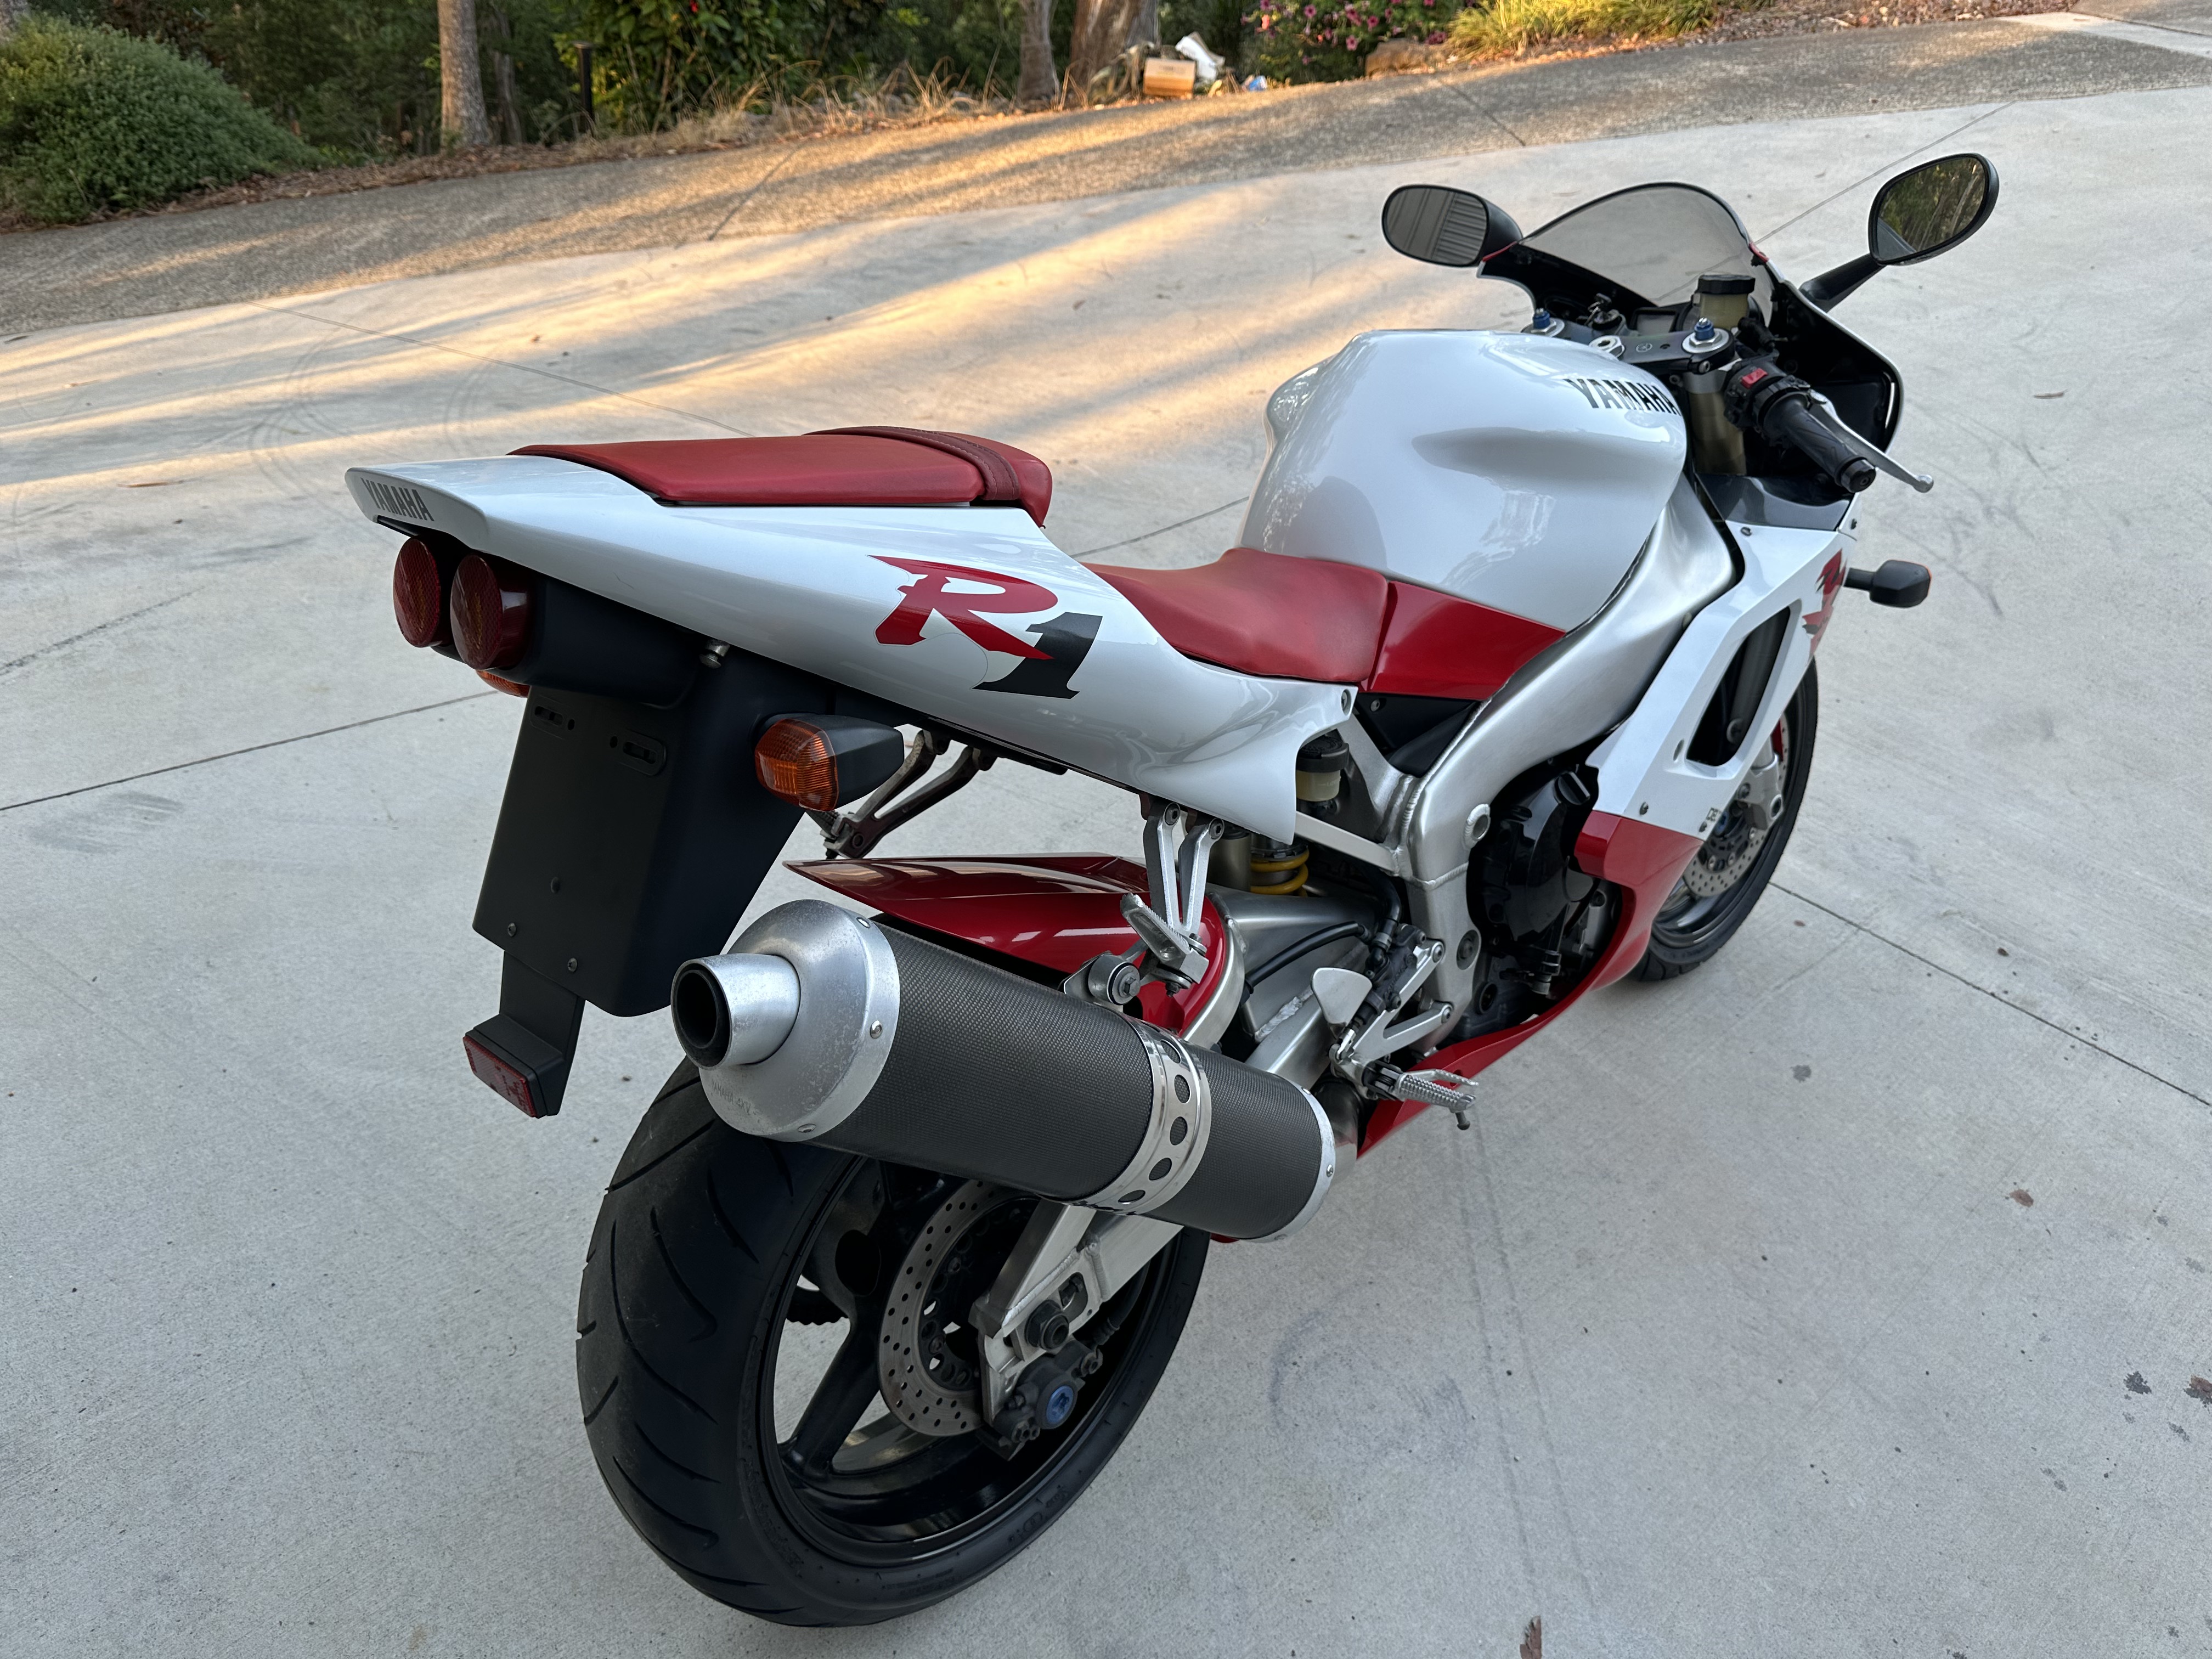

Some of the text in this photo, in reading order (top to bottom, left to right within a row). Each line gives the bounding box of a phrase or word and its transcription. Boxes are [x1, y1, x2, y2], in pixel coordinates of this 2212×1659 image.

[1563, 379, 1681, 416] YAMAHA
[360, 477, 435, 521] YAMAHA
[866, 555, 1103, 699] R1
[711, 1079, 734, 1105] YAMAHA
